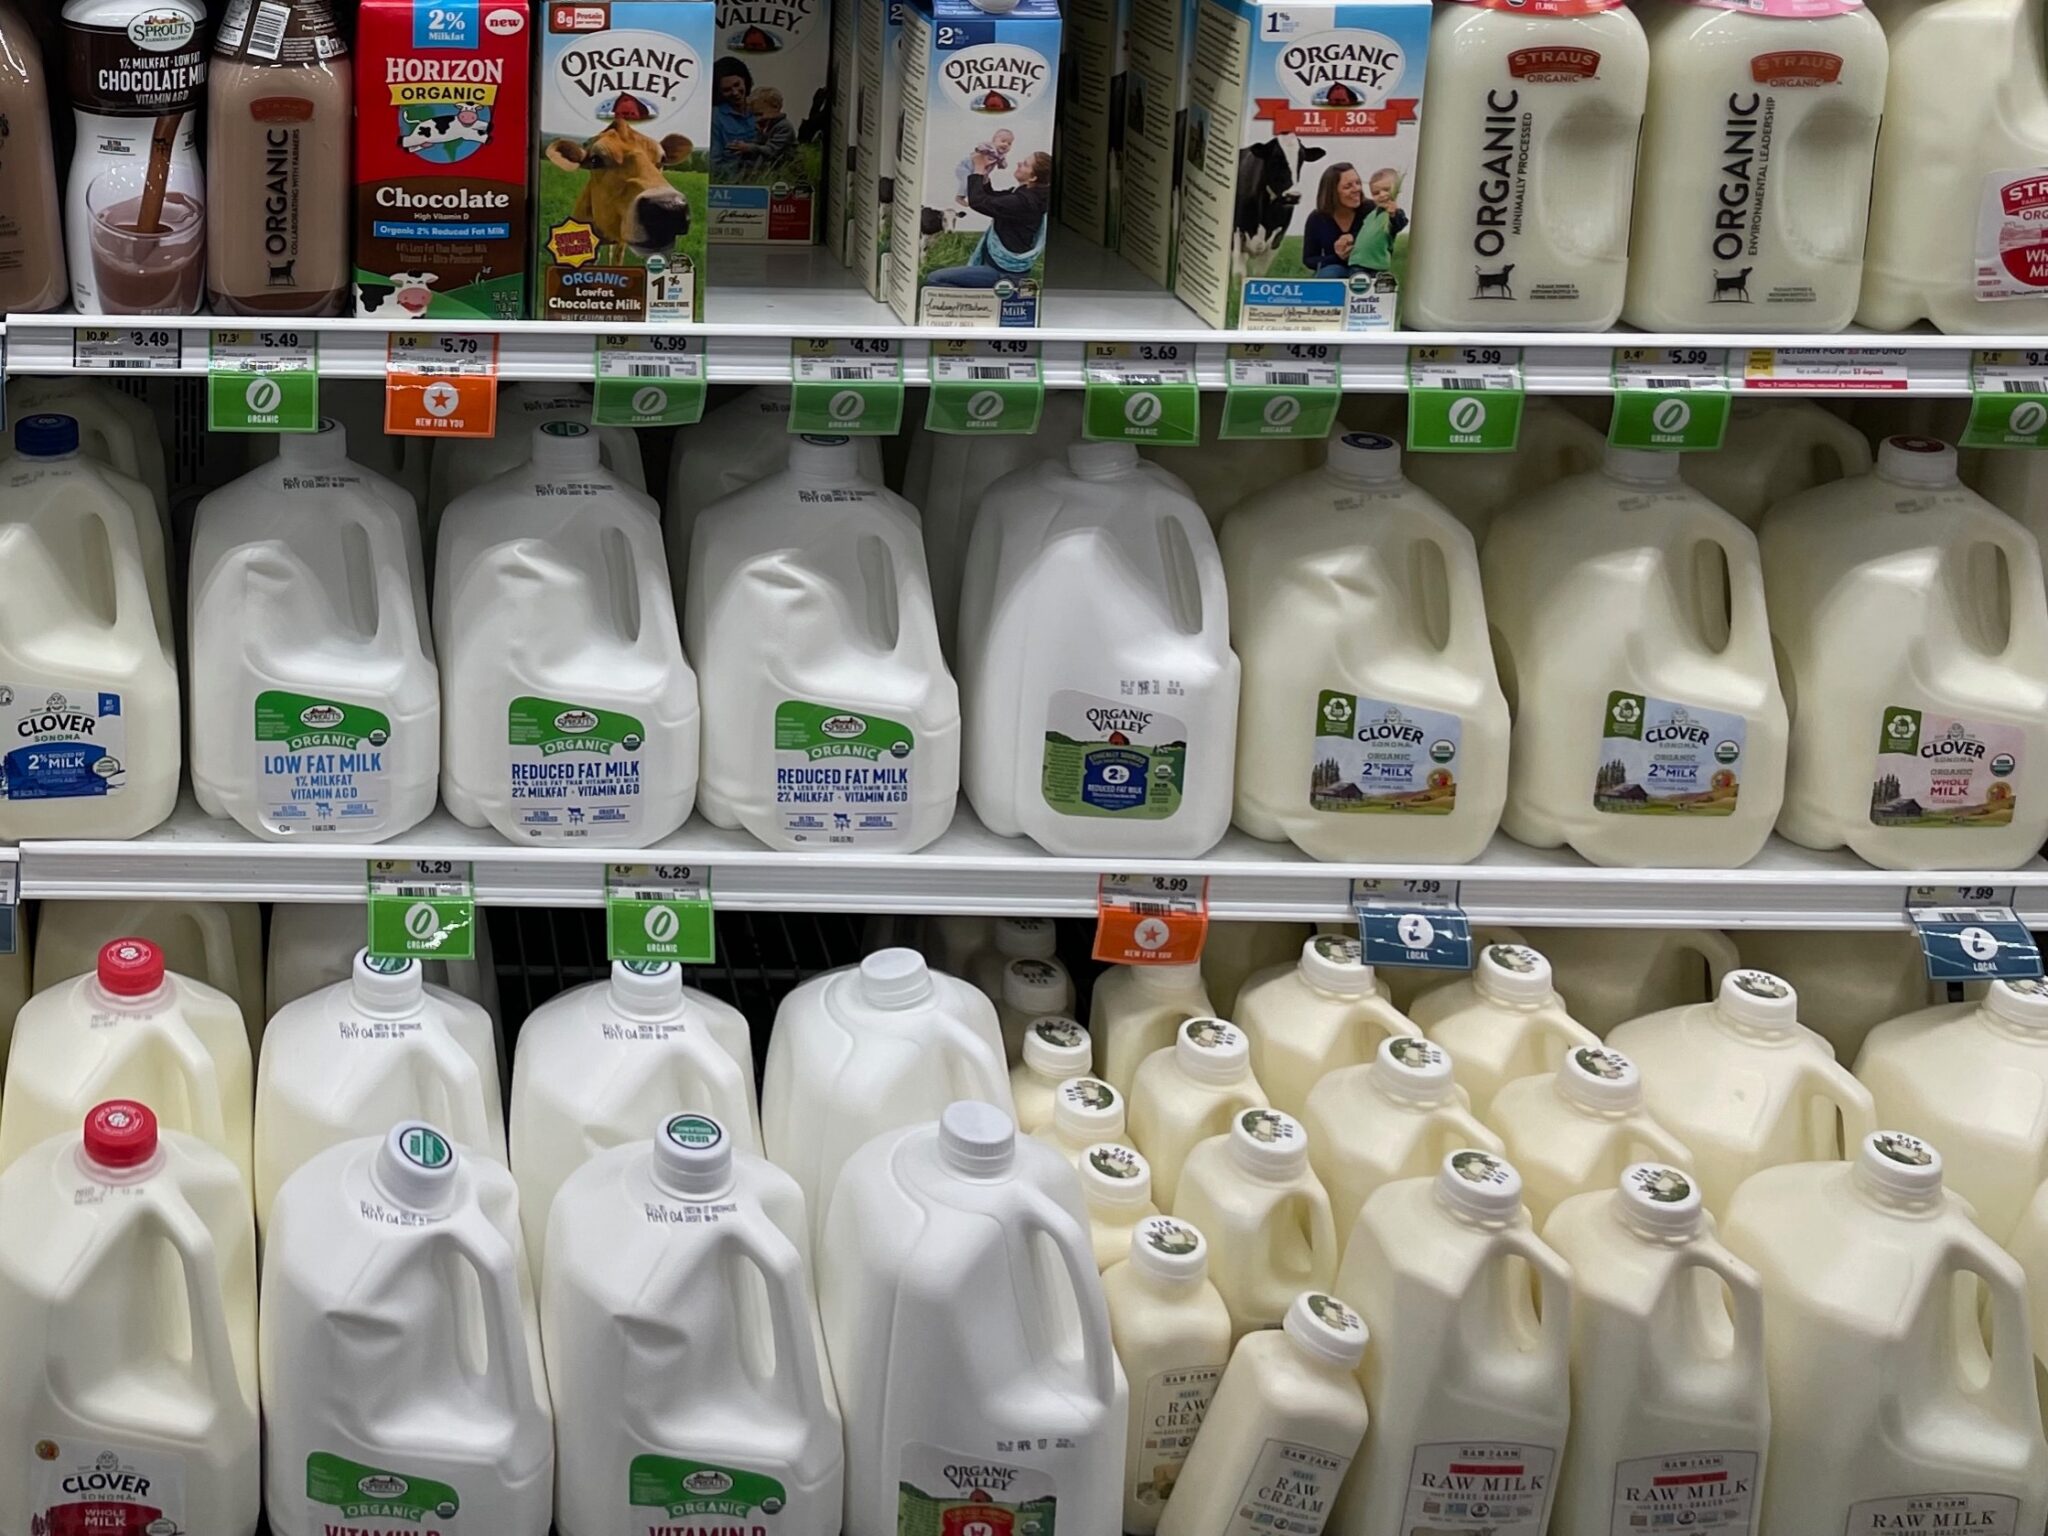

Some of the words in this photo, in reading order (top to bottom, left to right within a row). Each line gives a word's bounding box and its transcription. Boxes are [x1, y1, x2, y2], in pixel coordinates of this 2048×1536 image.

[428, 9, 466, 30] 2%
[489, 17, 520, 27] new
[133, 22, 192, 42] SPROUTS
[428, 31, 465, 41] Milkfat
[561, 47, 694, 79] ORGANIC
[1284, 44, 1399, 71] ORGANIC
[1515, 51, 1593, 66] STRAUS
[1758, 55, 1837, 71] STRAUS
[385, 57, 504, 83] HORIZON
[945, 57, 1045, 80] ORGANIC
[1295, 64, 1386, 88] VALLEY
[1527, 74, 1580, 83] ORGANIC
[574, 71, 680, 99] VALLEY
[955, 74, 1034, 95] VALLEY
[1770, 79, 1822, 88] ORGANIC
[401, 87, 486, 101] ORGANIC
[1517, 112, 1532, 177] PROCESSED
[1474, 89, 1519, 257] ORGANIC
[1713, 92, 1760, 260] ORGANIC
[1748, 164, 1768, 256] ENVIRONMENTAL
[1759, 96, 1776, 162] LEADERSHIP
[265, 129, 290, 255] ORGANIC
[376, 187, 510, 208] Chocolate
[1512, 177, 1527, 235] MINIMALLY
[414, 212, 431, 221] High
[433, 212, 462, 220] Vitamin
[380, 226, 414, 236] Organic
[417, 227, 430, 235] 2%
[432, 228, 469, 236] Reduced
[471, 228, 485, 236] Fat
[487, 227, 505, 235] Milk
[562, 272, 629, 287] ORGANIC
[575, 288, 615, 297] Lowfat
[1250, 284, 1303, 296] LOCAL
[548, 297, 614, 310] Chocolate
[615, 298, 641, 310] Milk
[1351, 296, 1380, 304] Lowfat
[1002, 307, 1027, 316] Milk
[1350, 304, 1377, 314] Milk
[130, 331, 169, 347] $3.49
[260, 332, 298, 347] $5.49
[440, 338, 477, 353] $5.79
[650, 336, 686, 351] $6.99
[1139, 346, 1177, 360] $3.69
[1463, 349, 1501, 364] $5.99
[1668, 350, 1707, 364] $5.99
[248, 415, 279, 424] ORGANIC
[415, 417, 431, 428] NEW
[433, 418, 447, 428] FOR
[449, 418, 464, 429] YOU
[828, 421, 861, 429] ORGANIC
[966, 420, 998, 428] ORGANIC
[1124, 427, 1158, 436] ORGANIC
[1651, 434, 1684, 443] ORGANIC
[1450, 434, 1481, 444] ORGANIC
[303, 711, 342, 723] SPROUTS
[1086, 708, 1153, 724] ORGANIC
[17, 714, 96, 737] CLOVER
[1092, 720, 1147, 734] VALLEY
[34, 733, 81, 742] SONOMA
[291, 734, 356, 749] ORGANIC
[1358, 726, 1424, 745] CLOVER
[1645, 727, 1710, 746] CLOVER
[545, 739, 610, 754] ORGANIC
[811, 745, 877, 760] ORGANIC
[1920, 741, 1986, 759] CLOVER
[28, 754, 48, 770] 2%
[49, 758, 85, 768] MILK
[265, 755, 302, 774] LOW
[307, 754, 335, 773] FAT
[339, 753, 381, 773] MILK
[1367, 753, 1411, 761] ORGANIC
[512, 763, 574, 780] REDUCED
[578, 763, 602, 778] FAT
[605, 761, 640, 777] MILK
[777, 768, 841, 784] REDUCED
[845, 768, 870, 784] FAT
[873, 768, 908, 784] MILK
[1108, 768, 1119, 780] 2
[1362, 763, 1381, 775] 2%
[1381, 768, 1413, 777] MILK
[1648, 764, 1666, 777] 2%
[1666, 769, 1697, 778] MILK
[1930, 768, 1974, 776] ORGANIC
[295, 776, 307, 786] 1%
[310, 774, 353, 786] MILKFAT
[1932, 778, 1970, 786] WHOLE
[512, 787, 526, 798] 2%
[528, 786, 568, 798] MILKFAT
[578, 785, 617, 797] VITAMIN
[1088, 784, 1115, 793] REDUCED
[1116, 785, 1128, 793] FAT
[1128, 786, 1142, 794] MILK
[1930, 787, 1969, 796] MILK
[777, 792, 791, 802] 2%
[793, 792, 834, 802] MILKFAT
[844, 792, 884, 802] VITAMIN
[416, 861, 452, 874] $6.29
[655, 866, 691, 879] $6.29
[1152, 877, 1188, 891] $8.99
[647, 943, 678, 953] ORGANIC
[1124, 950, 1140, 958] NEW
[1143, 951, 1156, 959] FOR
[1406, 951, 1428, 961] LOCAL
[1973, 962, 1998, 972] LOCAL
[679, 1134, 710, 1144] USDA
[1165, 1374, 1187, 1384] RAW
[1190, 1372, 1218, 1381] FARM
[1284, 1449, 1307, 1460] RAW
[1310, 1455, 1338, 1469] FARM
[1462, 1450, 1486, 1458] RAW
[1490, 1449, 1520, 1458] FARM
[1664, 1460, 1687, 1468] RAW
[1691, 1458, 1721, 1467] FARM
[944, 1465, 1019, 1481] ORGANIC
[62, 1473, 150, 1497] CLOVER
[950, 1475, 1013, 1491] VALLEY
[1275, 1477, 1320, 1498] RAW
[1421, 1472, 1474, 1491] RAW
[1482, 1475, 1545, 1491] MILK
[1626, 1486, 1679, 1502] RAW
[1688, 1479, 1748, 1500] MILK
[1258, 1486, 1325, 1514] CREAM
[1937, 1500, 1966, 1508] FARM
[84, 1508, 127, 1517] WHOLE
[347, 1504, 421, 1520] ORGANIC
[672, 1502, 745, 1516] ORGANIC
[84, 1517, 127, 1527] MILK
[1871, 1513, 1926, 1528] RAW
[1932, 1510, 1998, 1528] MILK
